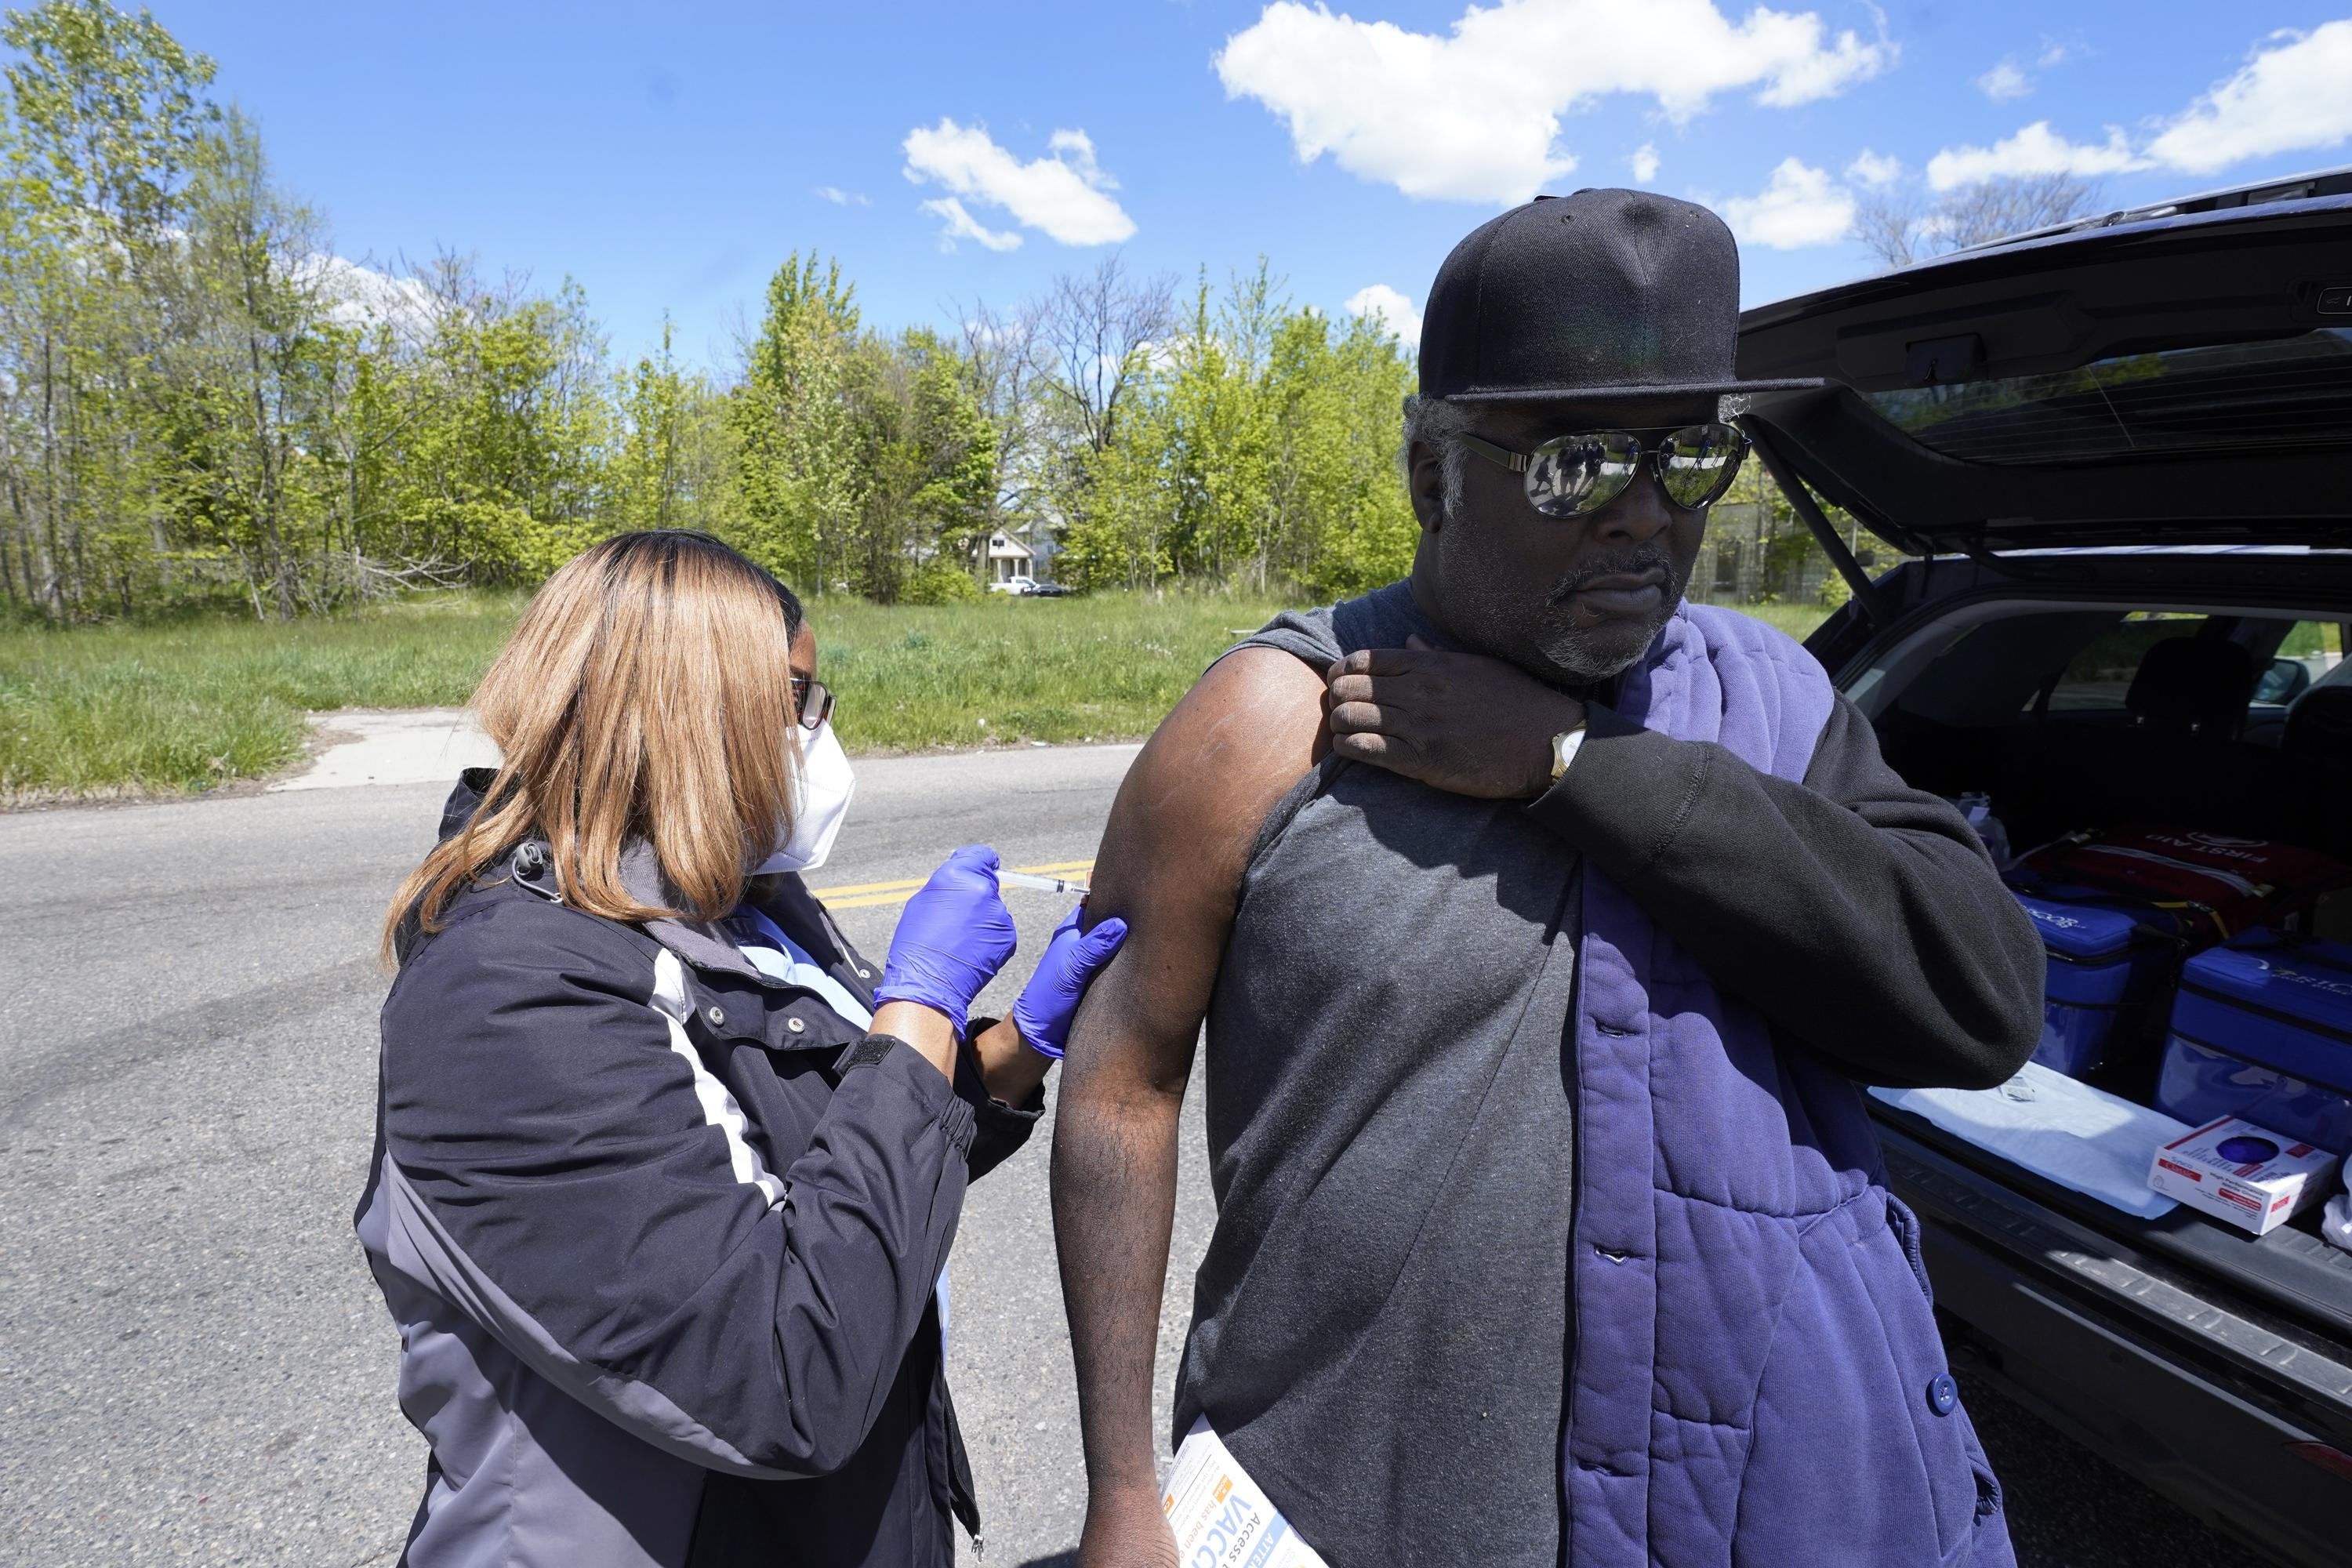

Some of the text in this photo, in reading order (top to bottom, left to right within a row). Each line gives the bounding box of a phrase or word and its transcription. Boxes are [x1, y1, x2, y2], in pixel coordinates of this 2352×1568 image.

[2144, 834, 2269, 863] FIRST AID
[2209, 1171, 2223, 1180] High
[1201, 1500, 1217, 1520] has
[1185, 1521, 1203, 1548] been
[1229, 1512, 1261, 1563] Access
